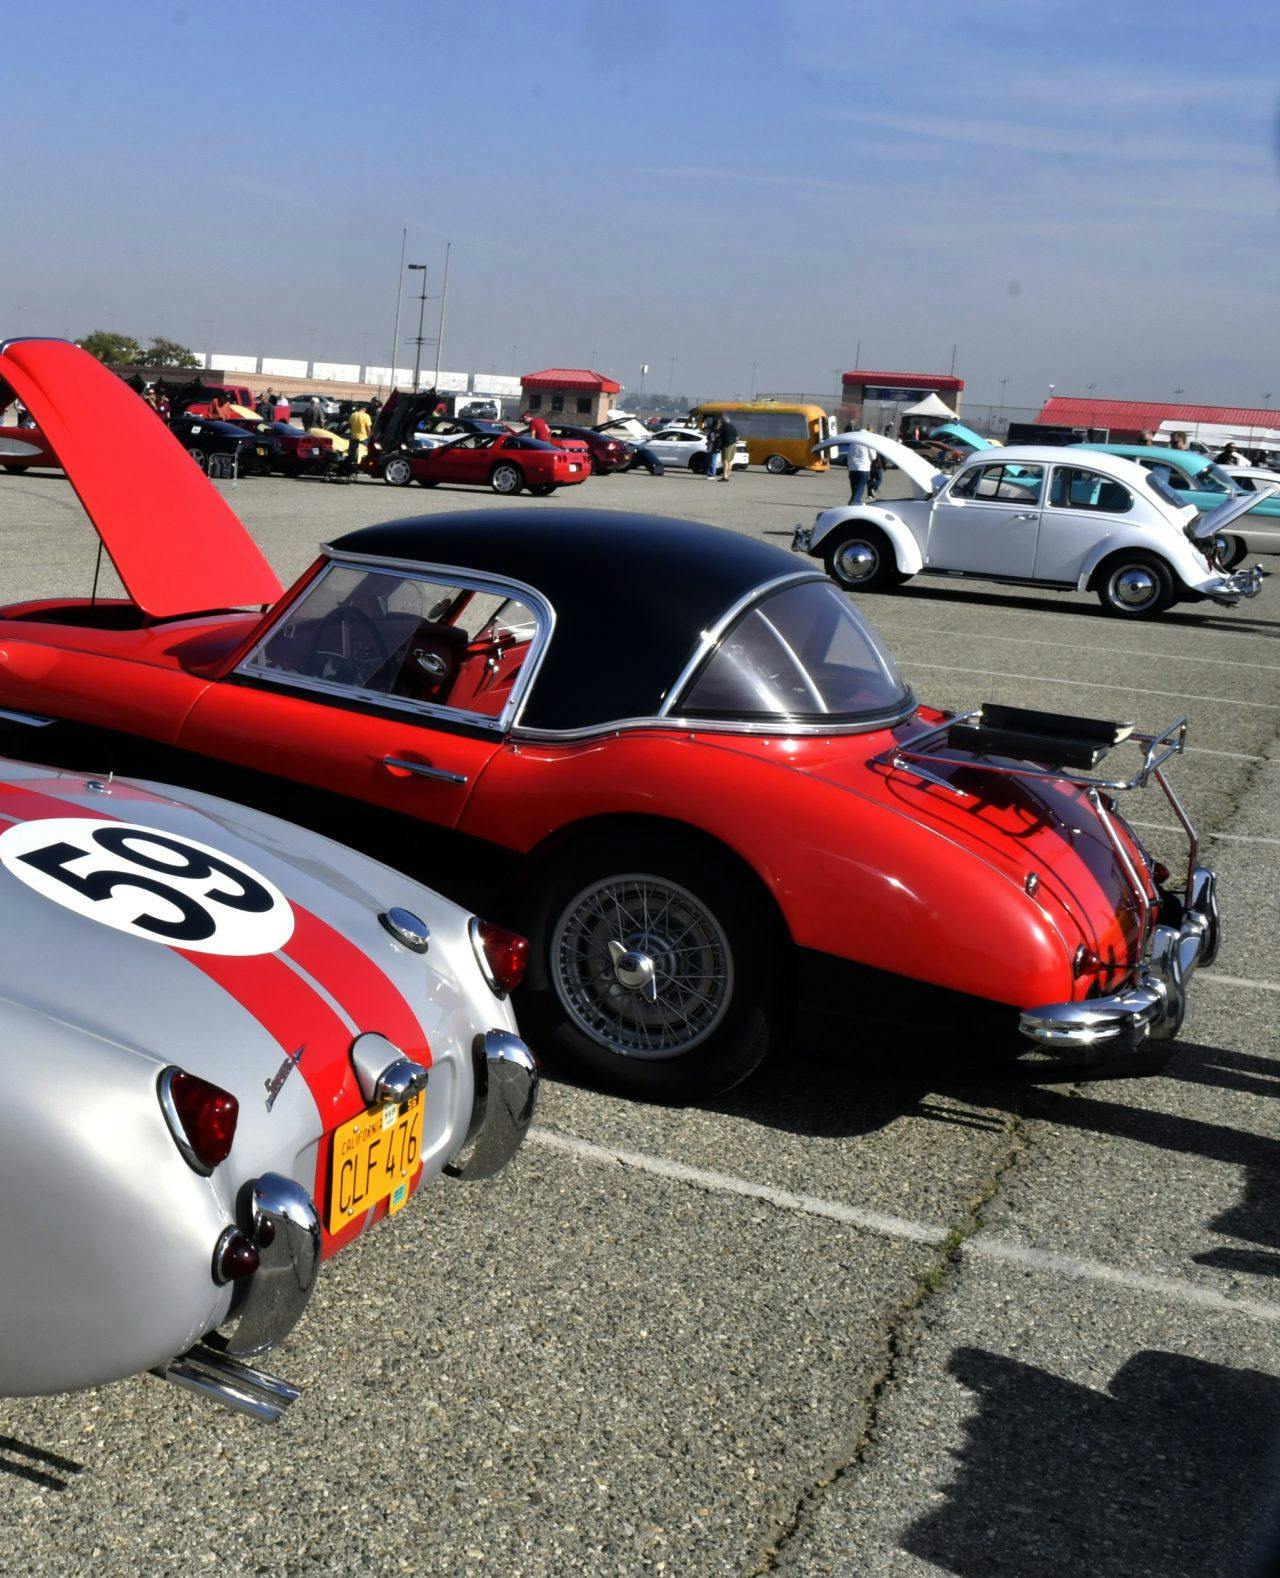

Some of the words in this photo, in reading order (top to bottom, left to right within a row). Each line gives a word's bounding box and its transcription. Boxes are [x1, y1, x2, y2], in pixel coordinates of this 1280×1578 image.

[16, 827, 275, 941] 59
[339, 1139, 381, 1213] CLF
[386, 1112, 419, 1178] 476
